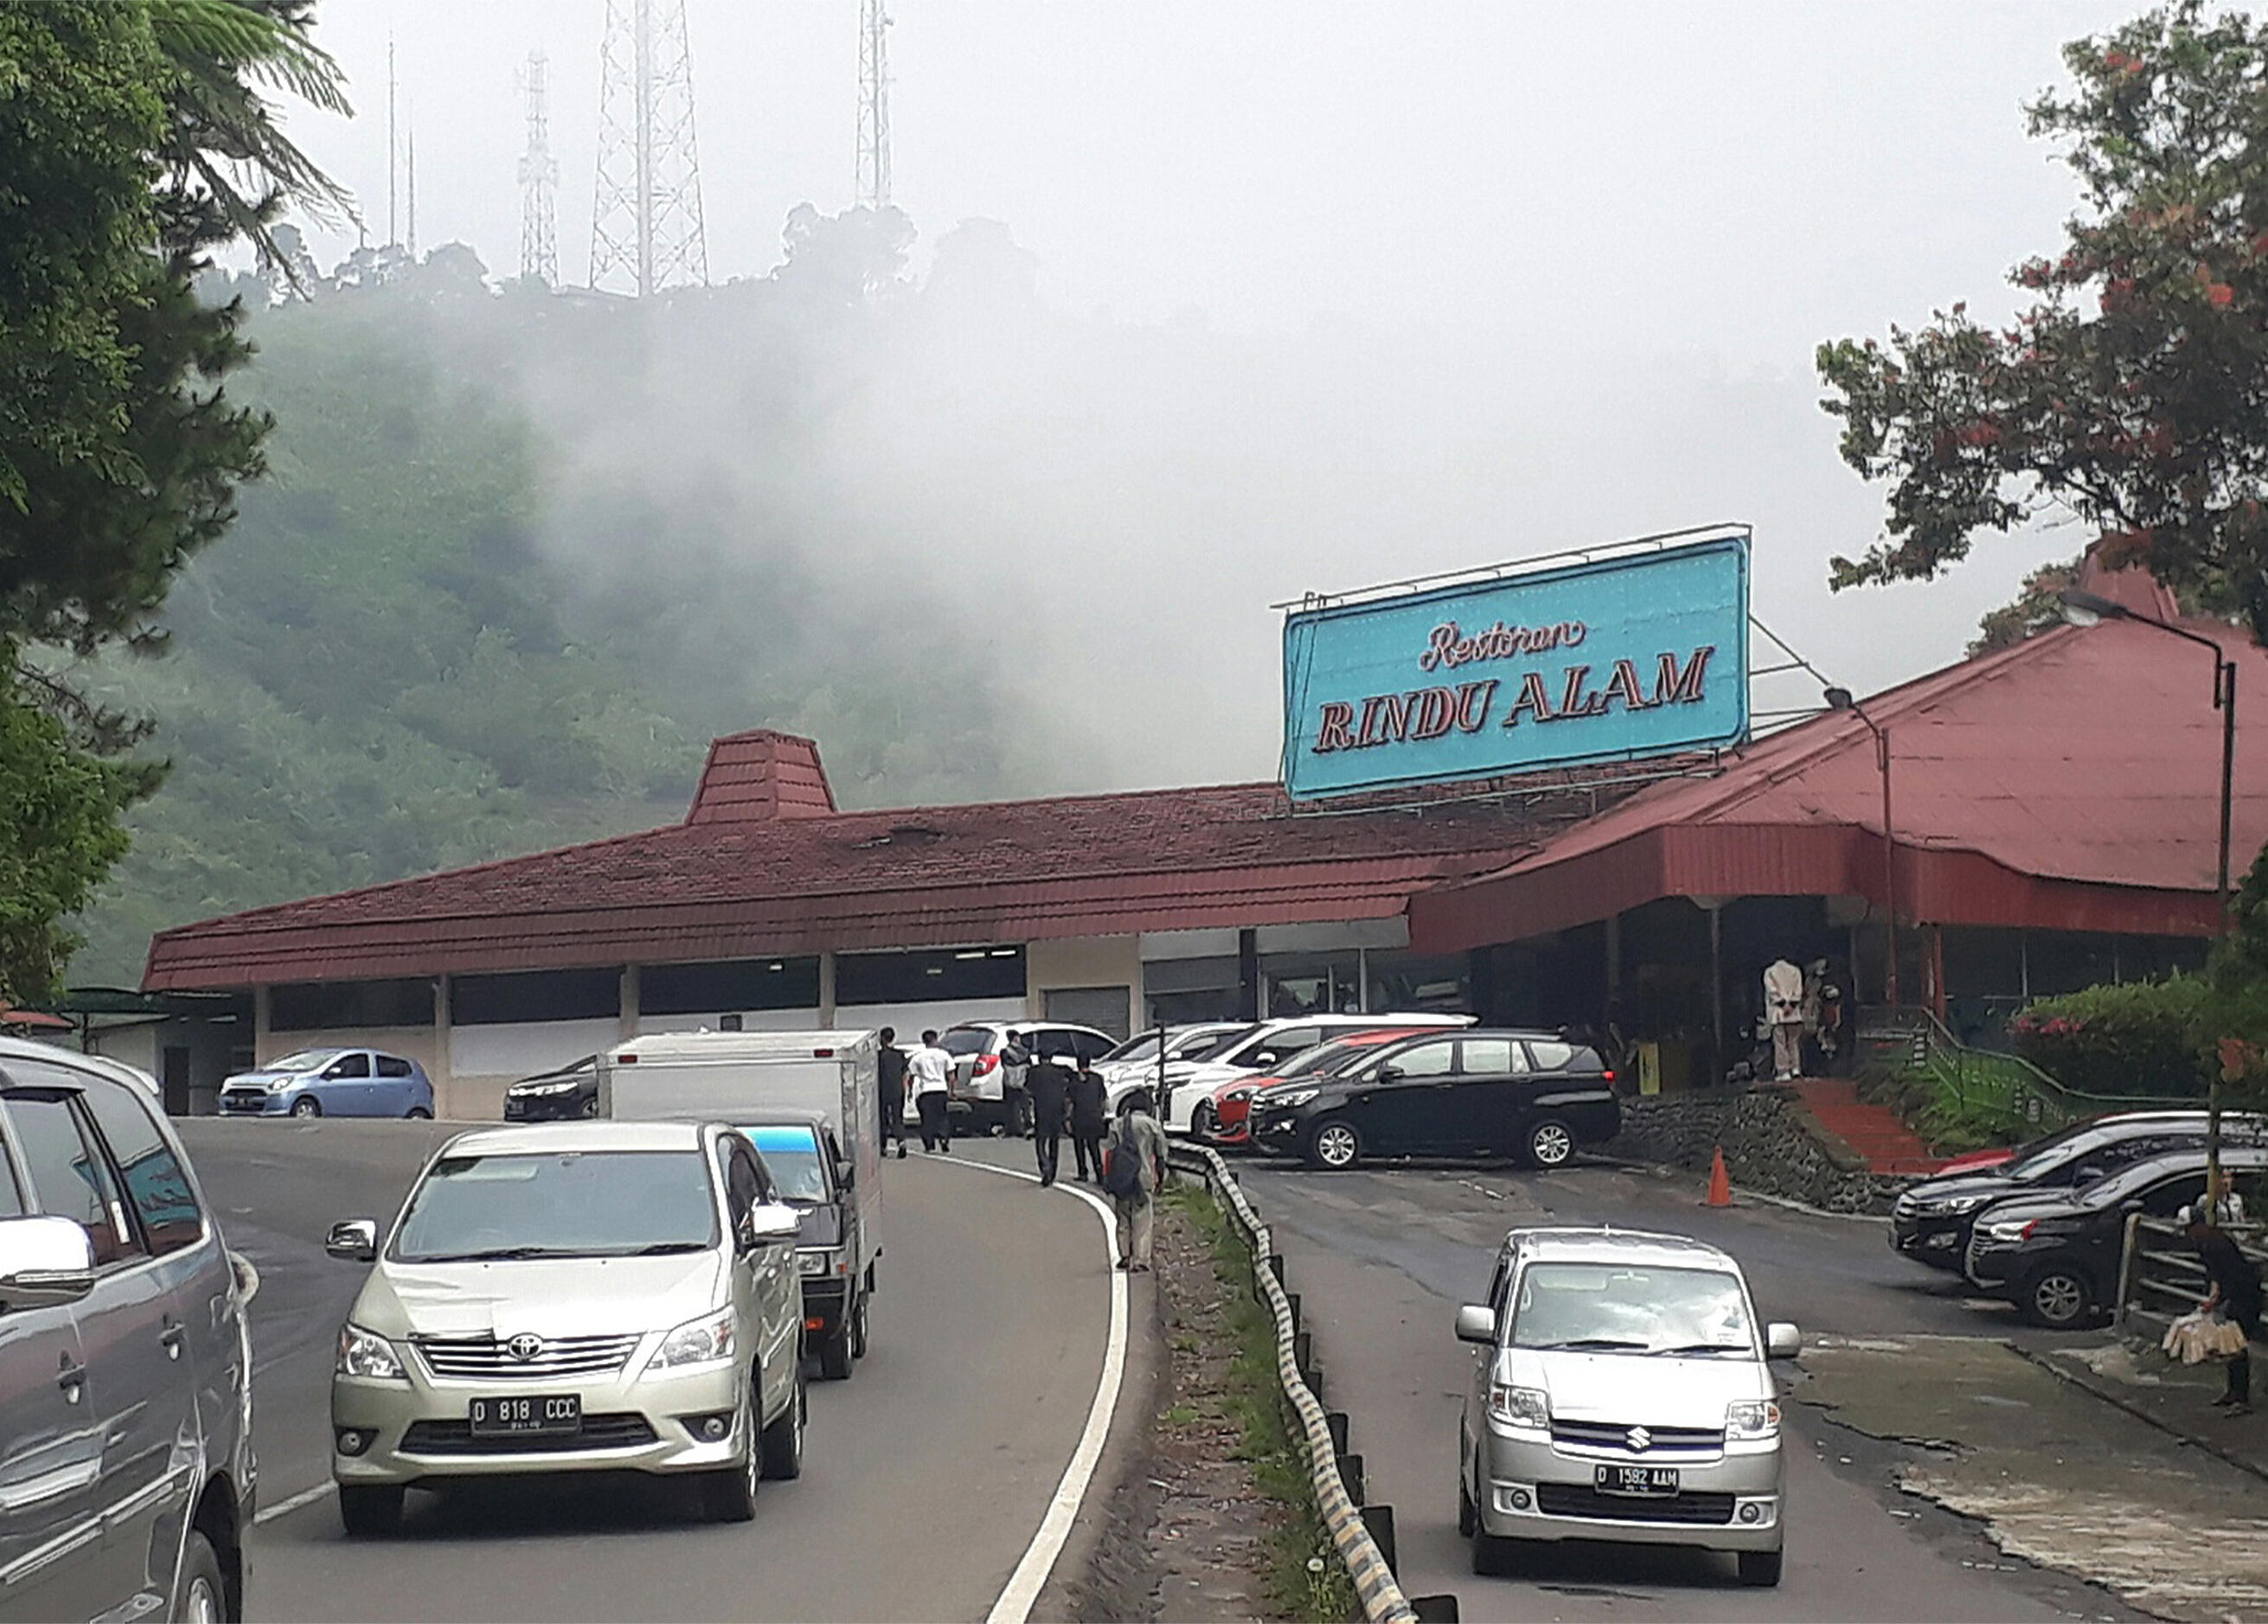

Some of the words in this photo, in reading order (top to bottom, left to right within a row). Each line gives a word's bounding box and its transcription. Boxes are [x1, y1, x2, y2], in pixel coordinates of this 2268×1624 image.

[1418, 620, 1586, 672] Restoran
[1311, 678, 1500, 754] RINDU
[1502, 645, 1715, 727] ALAM
[500, 1400, 529, 1421] 818
[546, 1398, 575, 1418] CCC
